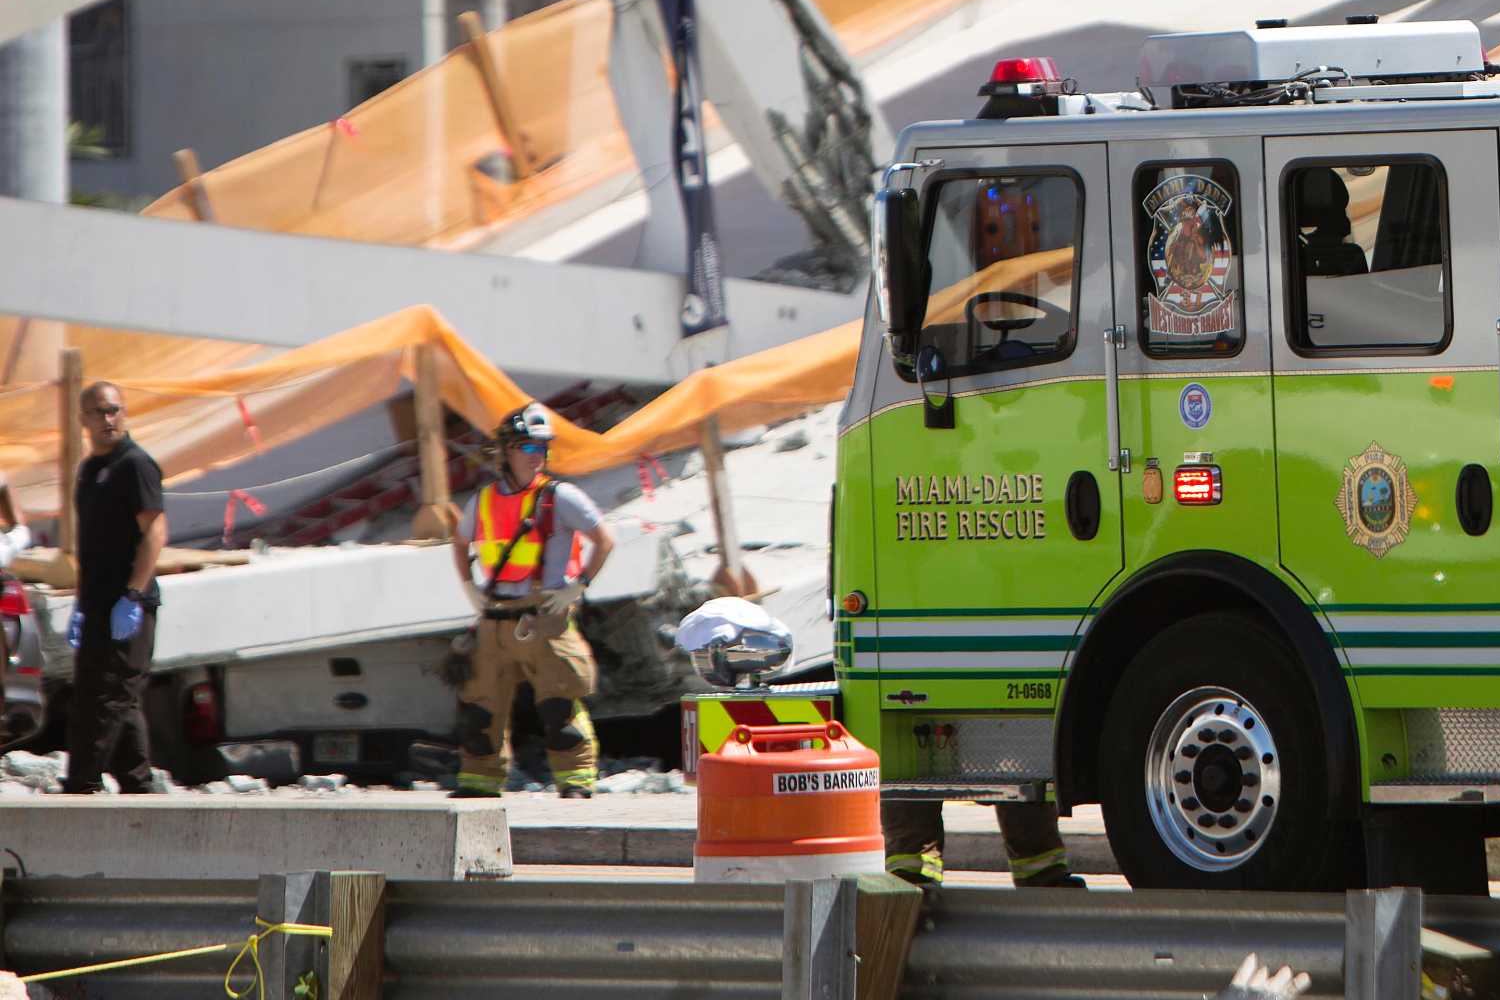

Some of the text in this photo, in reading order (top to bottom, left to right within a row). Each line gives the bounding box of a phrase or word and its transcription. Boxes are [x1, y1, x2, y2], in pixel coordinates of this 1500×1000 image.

[895, 473, 1044, 506] MIAMI-DADE
[896, 509, 1047, 541] FIRE RESCUE
[1006, 682, 1052, 700] 21-0568
[777, 774, 820, 792] BOB'S
